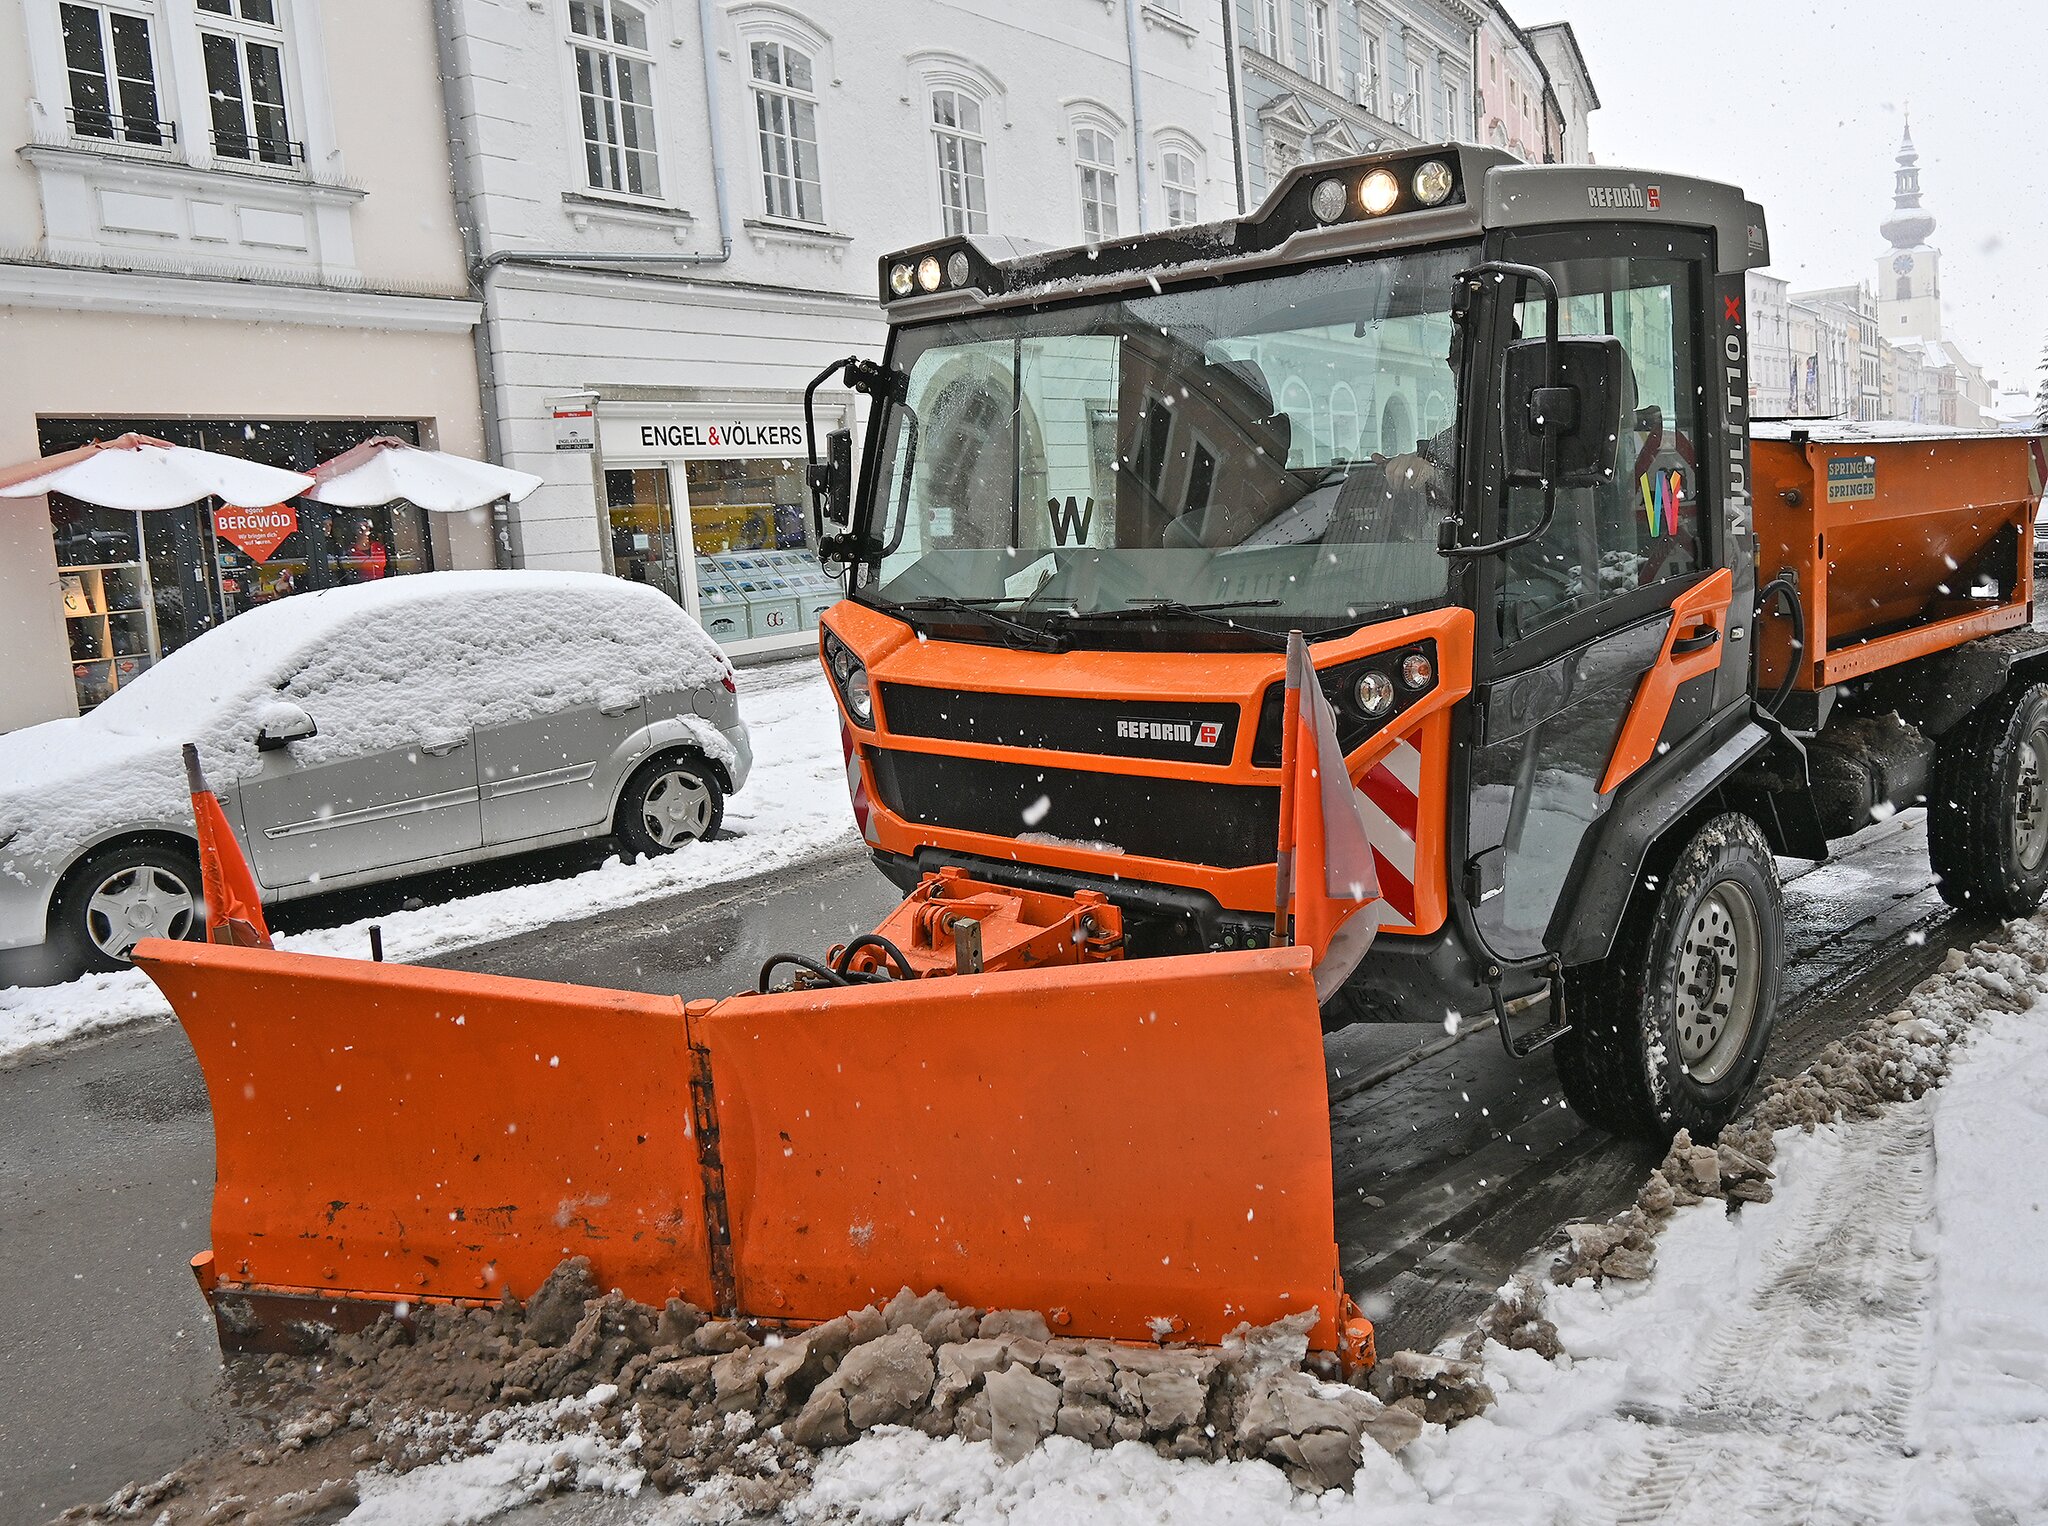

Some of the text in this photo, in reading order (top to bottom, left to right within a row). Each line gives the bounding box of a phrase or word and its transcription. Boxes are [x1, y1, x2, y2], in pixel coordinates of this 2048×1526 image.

[1587, 186, 1644, 208] REFORM
[641, 421, 802, 446] ENGEL&VÖLKERS
[1729, 423, 1746, 536] MULI
[1829, 461, 1874, 476] SPRINGER
[1829, 483, 1874, 498] SPRINGER
[218, 511, 291, 530] BERGWÖD
[1048, 496, 1094, 546] W
[1117, 720, 1191, 742] REFORM
